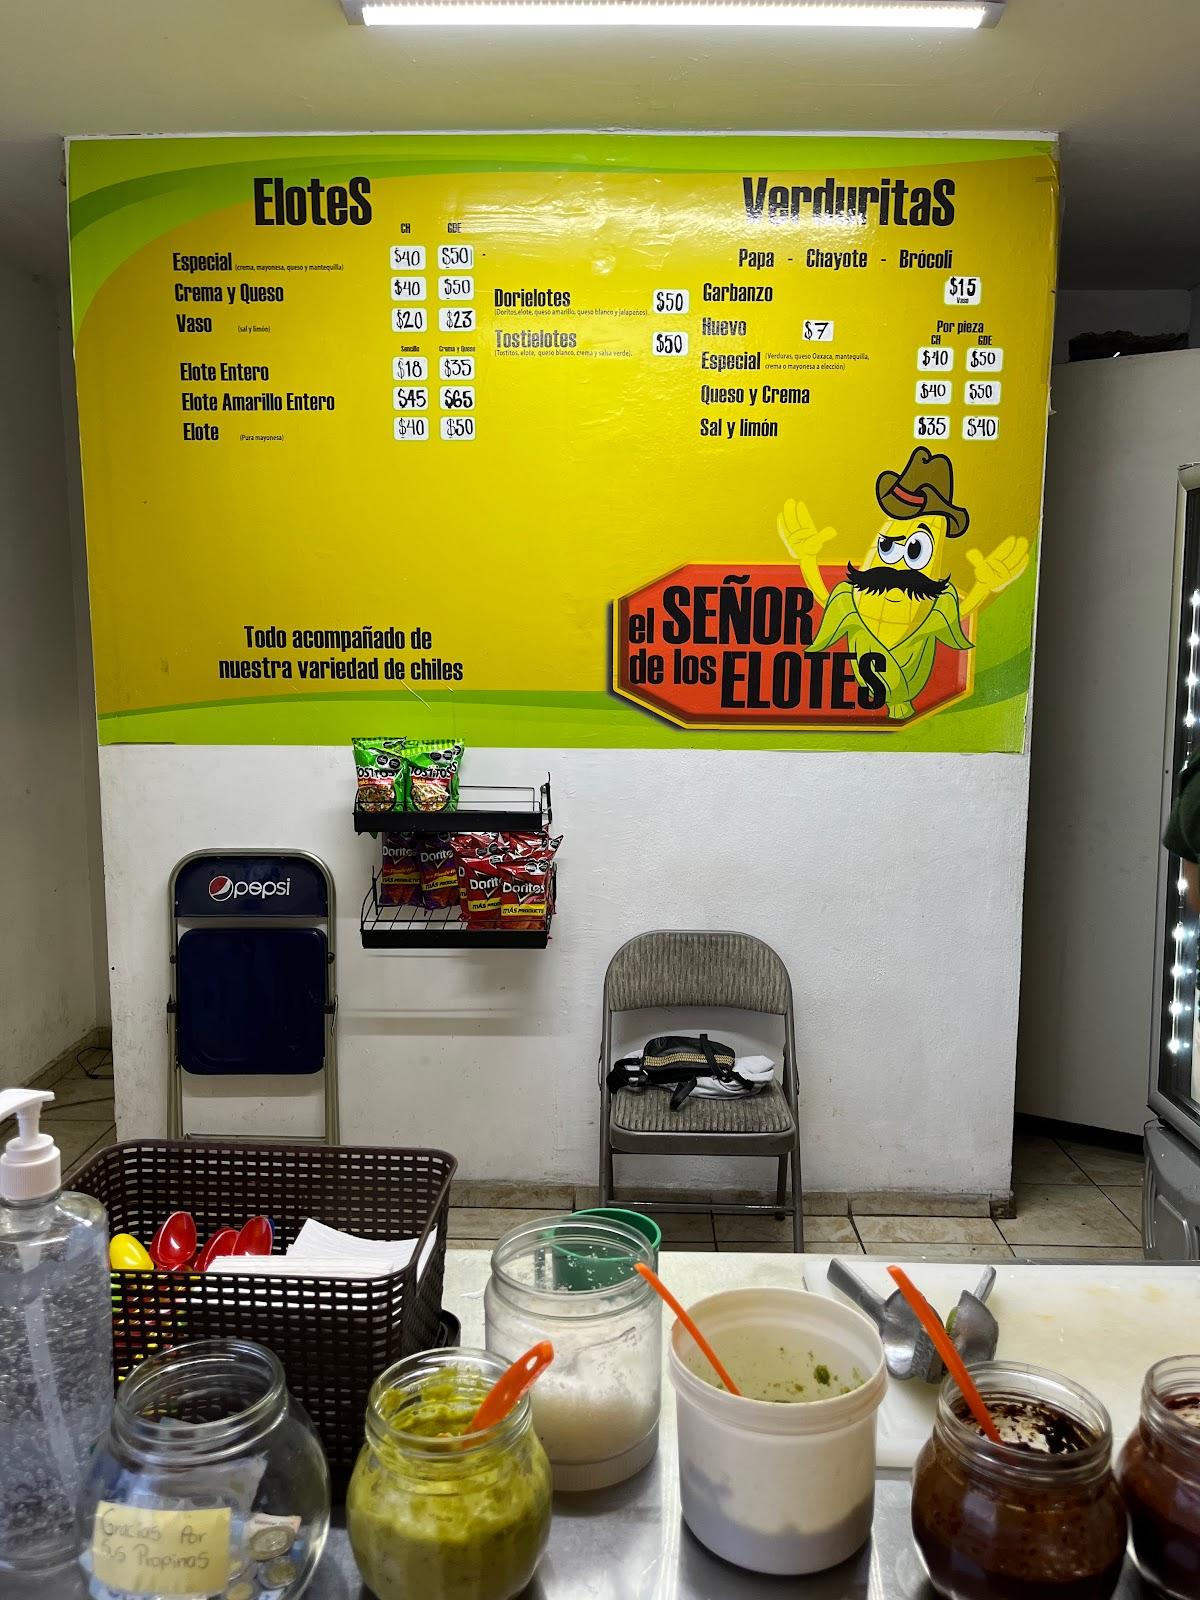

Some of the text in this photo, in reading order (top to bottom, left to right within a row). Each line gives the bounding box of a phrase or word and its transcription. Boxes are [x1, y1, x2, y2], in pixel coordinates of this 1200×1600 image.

[254, 176, 372, 225] EloteS
[400, 223, 461, 233] CH GDE
[172, 252, 232, 274] Especial
[395, 249, 420, 267] $40
[442, 247, 469, 268] $50
[739, 249, 774, 270] Papa
[807, 249, 867, 270] Chayote
[899, 249, 952, 269] Brócoli
[175, 283, 284, 304] Crema y Queso
[395, 281, 420, 296] $40
[444, 279, 470, 295] $50
[703, 283, 772, 302] Garbanzo
[950, 277, 976, 297] $15
[495, 289, 570, 307] Dorielotes
[657, 291, 683, 312] $50
[176, 314, 212, 333] Vaso
[396, 311, 423, 329] $20
[446, 310, 472, 329] $23
[702, 318, 746, 336] Huevo
[937, 320, 984, 335] Por pieza
[495, 330, 576, 348] Tostielotes
[804, 322, 829, 340] $7
[931, 335, 992, 345] CH GDE
[657, 334, 683, 353] $50
[702, 352, 760, 372] Especial
[835, 353, 869, 361] mantequilla,
[922, 350, 948, 366] $40
[971, 350, 995, 368] $50
[180, 363, 269, 381] Elote Entero
[397, 358, 422, 378] $18
[444, 359, 472, 377] $35
[398, 390, 426, 408] $45
[444, 390, 473, 409] $65
[701, 385, 810, 405] Queso y Crema
[920, 382, 946, 398] $40
[970, 384, 992, 400] $50
[182, 393, 335, 411] Elote Amarillo Entero
[183, 423, 284, 442] Elote (Pura mayonesa)
[398, 419, 424, 438] $40
[447, 418, 473, 438] $50
[700, 419, 778, 439] Sal y limón
[919, 418, 946, 435] $35
[967, 419, 996, 437] $40
[629, 574, 814, 645] el SEÑOR
[244, 626, 432, 652] Todo acompañado de
[219, 657, 463, 681] nuestra variedad de chiles
[629, 649, 886, 710] de los ELOTES
[234, 878, 290, 898] pepsi
[101, 1508, 161, 1542] Gracias
